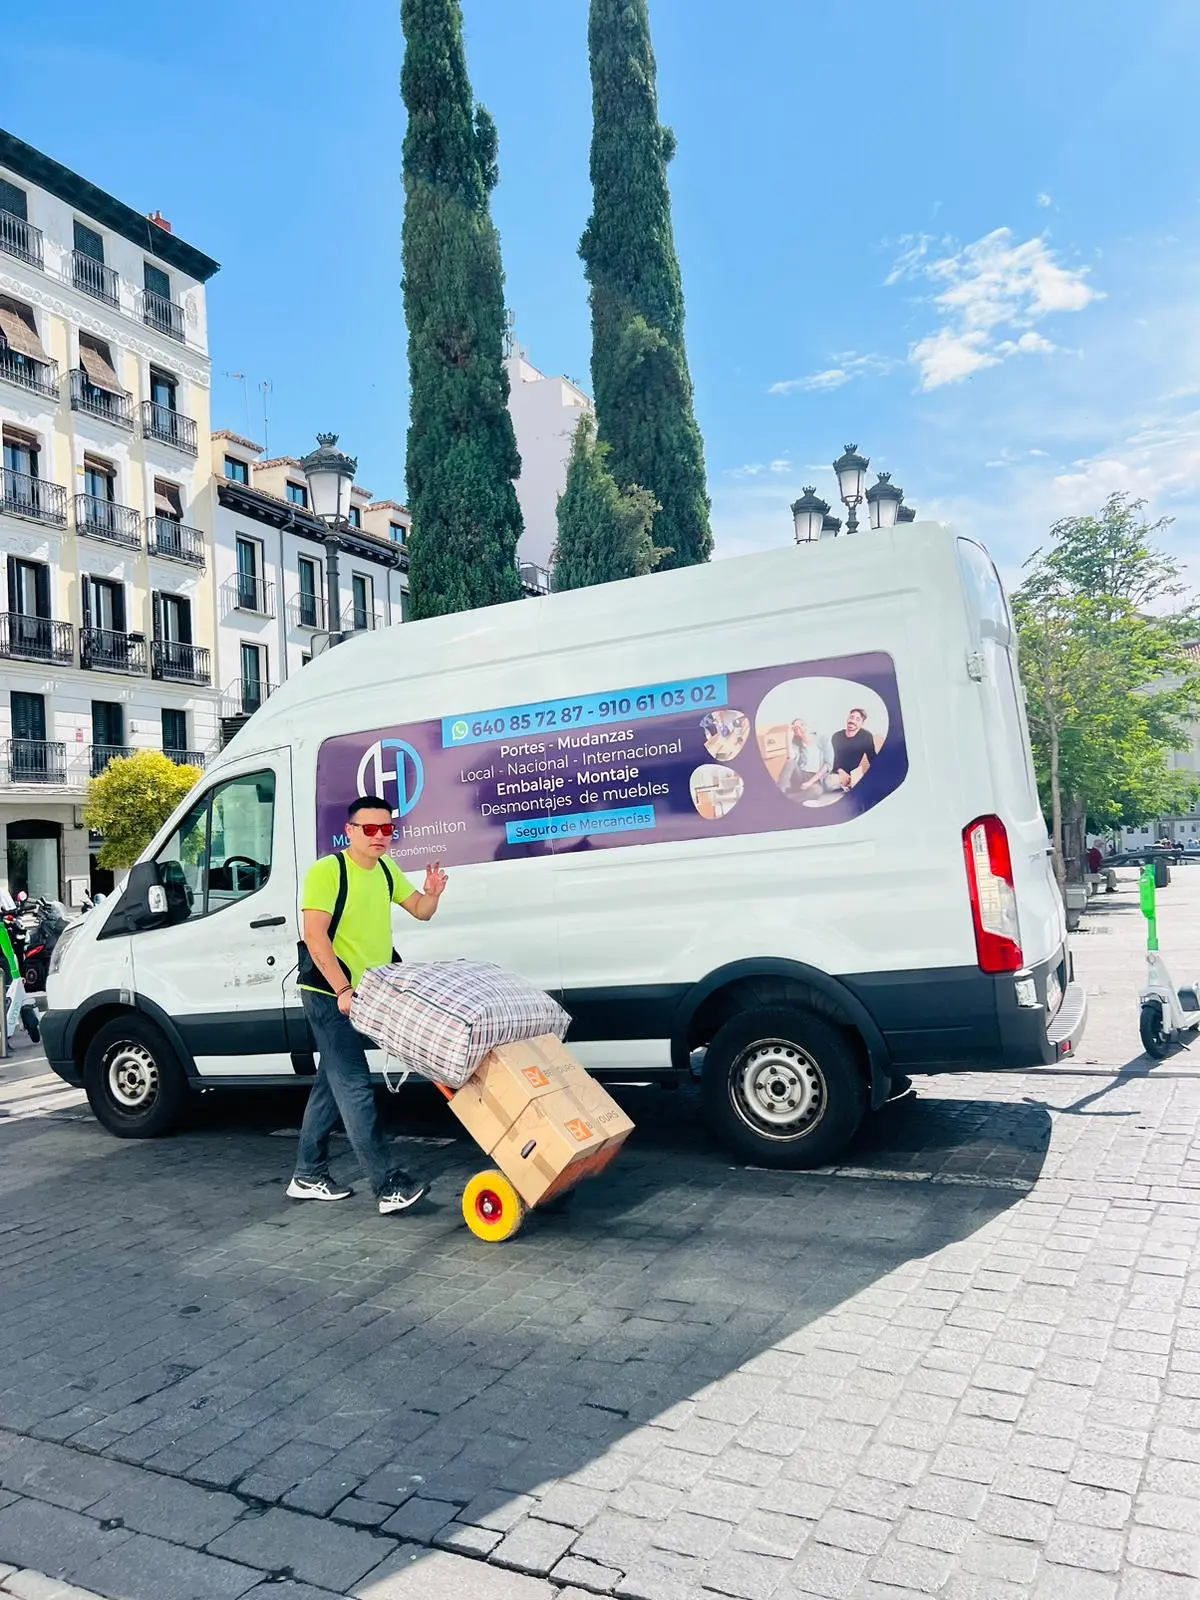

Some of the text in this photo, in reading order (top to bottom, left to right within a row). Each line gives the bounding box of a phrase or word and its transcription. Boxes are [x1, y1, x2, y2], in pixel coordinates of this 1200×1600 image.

[471, 718, 505, 737] 640
[509, 714, 531, 731] 85
[535, 710, 556, 727] 72
[561, 706, 583, 723] 87
[599, 698, 631, 717] 910
[636, 694, 655, 711] 61
[661, 689, 685, 708] 03
[691, 684, 716, 703] 02
[500, 742, 545, 758] Portes
[557, 730, 634, 750] Mudanzas
[460, 765, 495, 782] Local
[507, 754, 569, 775] Nacional
[582, 738, 682, 765] Internacional
[496, 775, 564, 796] Embalaje
[576, 765, 639, 785] Montaje
[481, 782, 669, 816] Desmontajes de muebles
[402, 820, 467, 839] Hamilton
[515, 812, 651, 838] Seguro de Mercancías
[390, 843, 448, 858] Económicos
